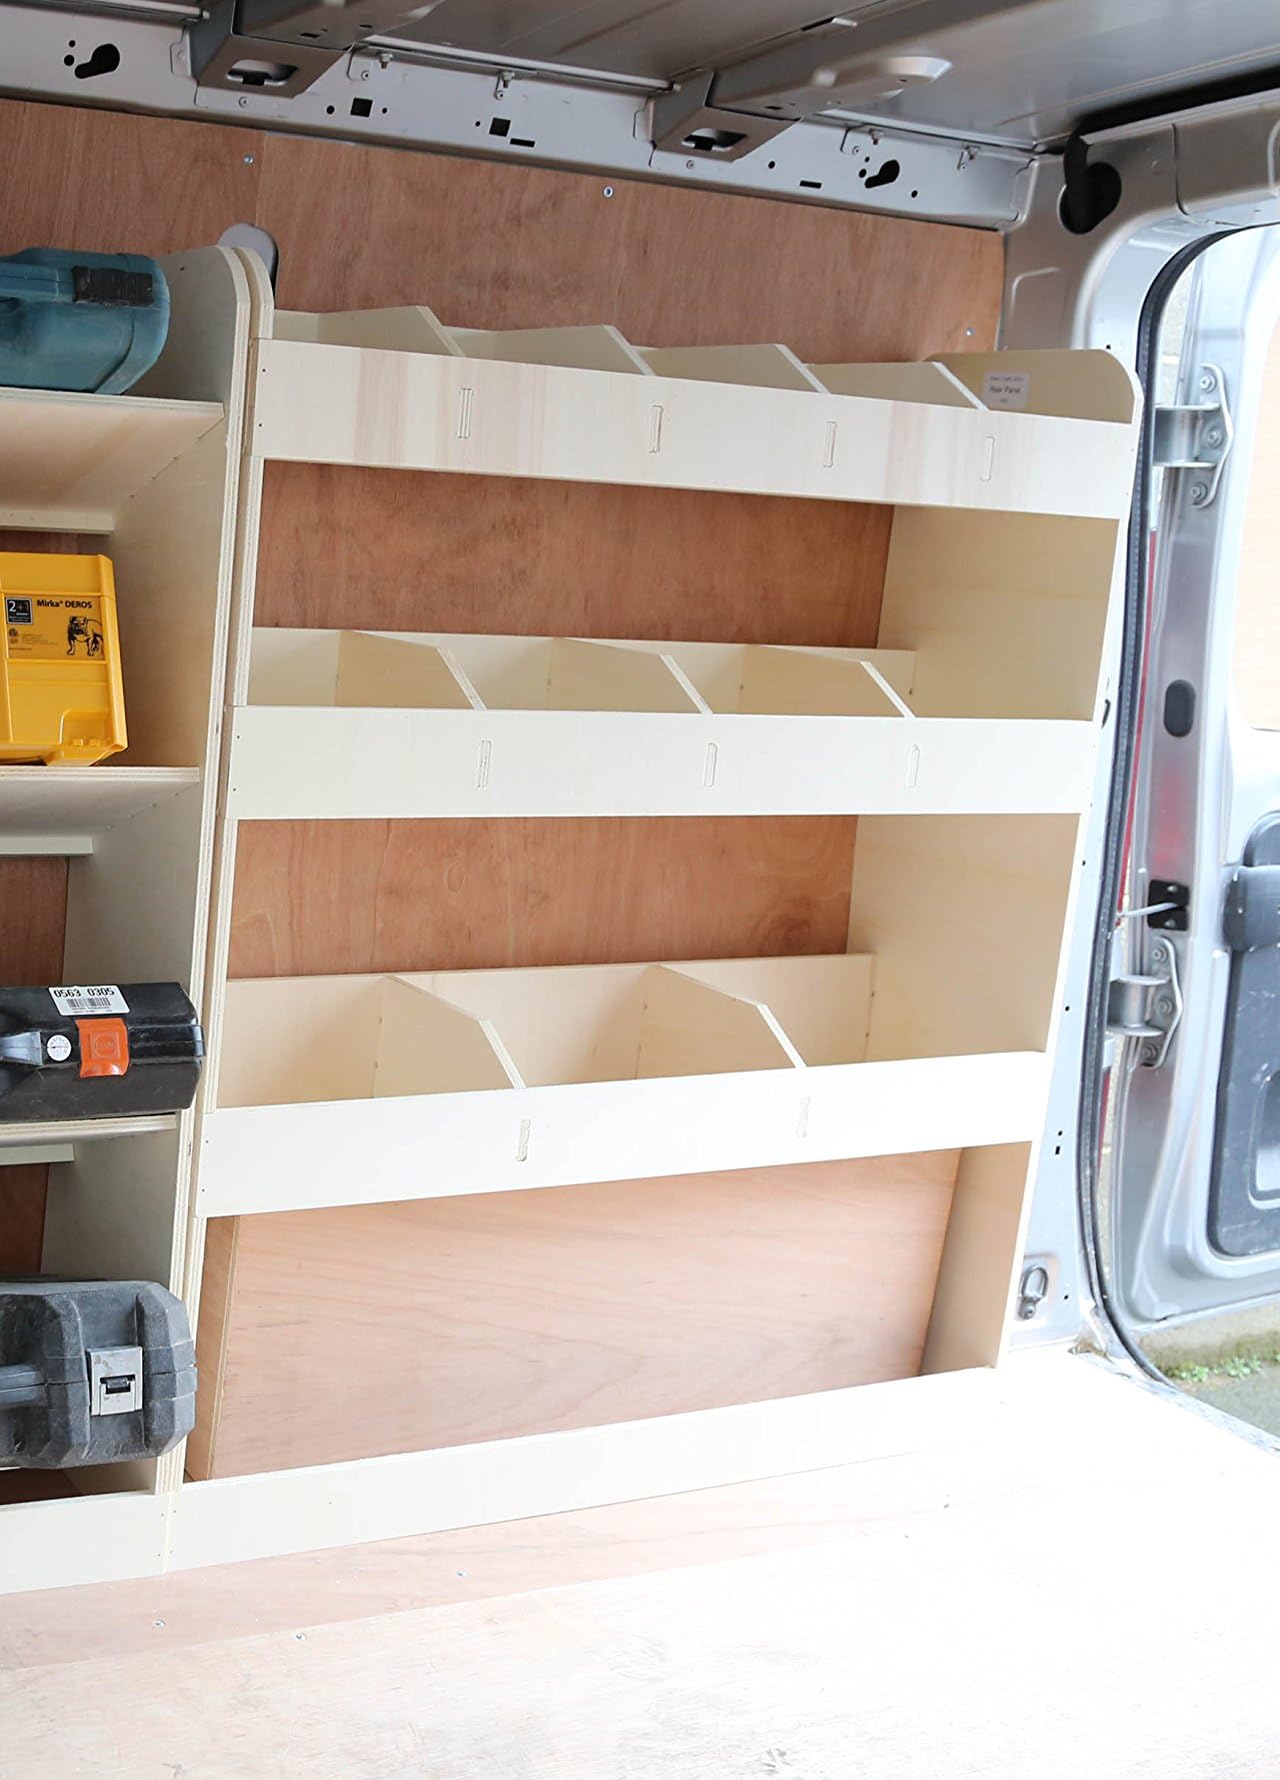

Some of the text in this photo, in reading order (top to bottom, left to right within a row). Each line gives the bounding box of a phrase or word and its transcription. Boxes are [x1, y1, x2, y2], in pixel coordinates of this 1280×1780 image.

[65, 600, 93, 609] DEROS
[53, 986, 115, 998] 0563 0305
